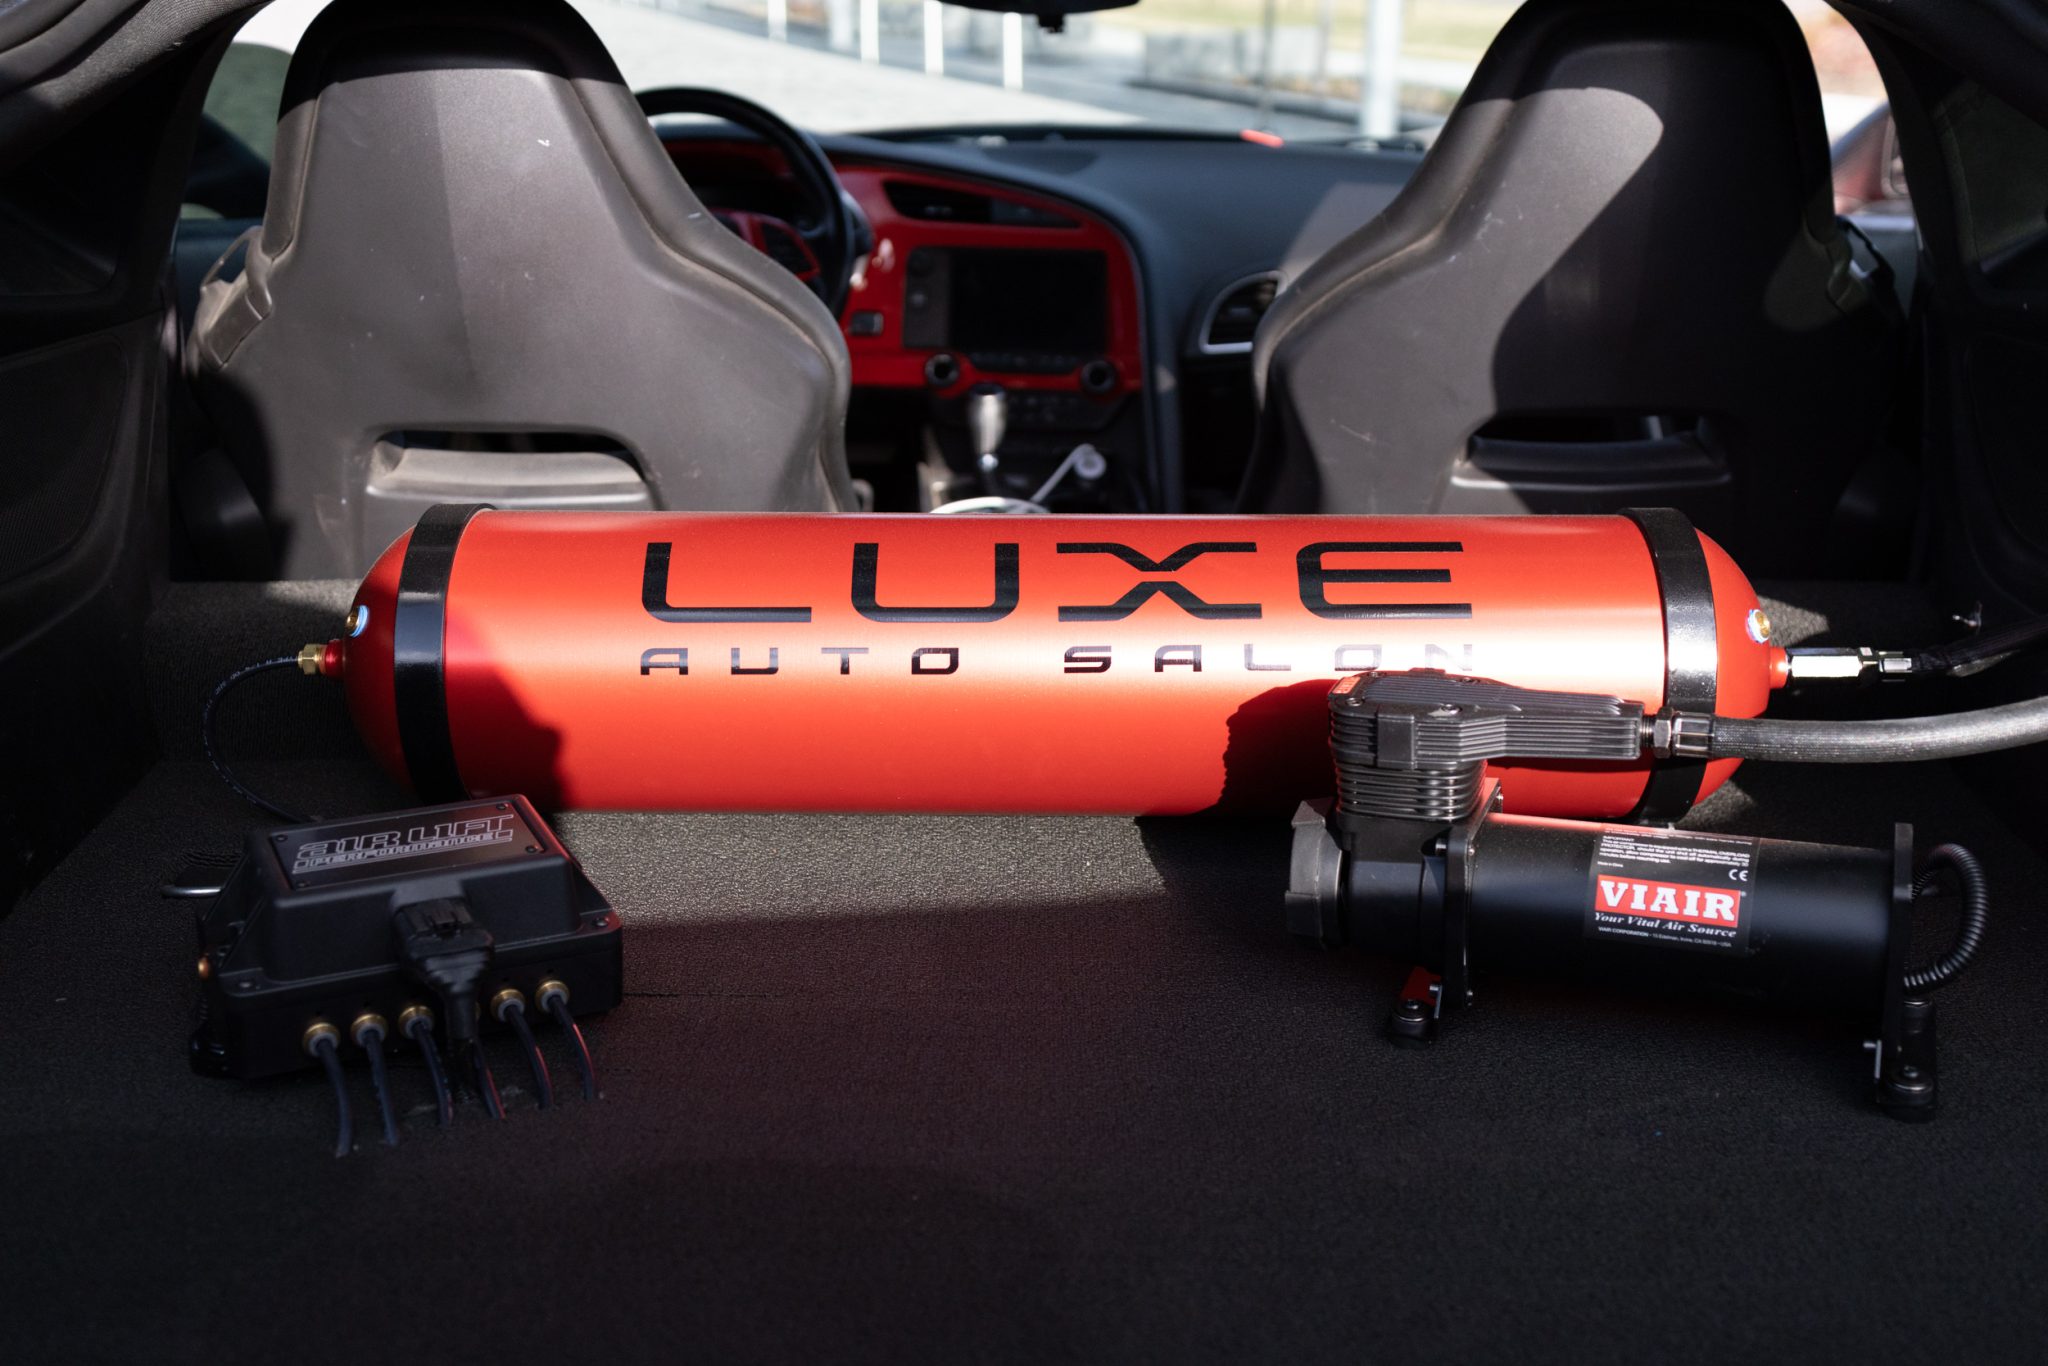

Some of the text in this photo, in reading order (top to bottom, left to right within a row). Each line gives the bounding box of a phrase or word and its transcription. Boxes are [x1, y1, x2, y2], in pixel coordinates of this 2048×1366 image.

[641, 541, 1472, 622] LUXE
[640, 643, 1473, 675] AUTO SALON
[408, 814, 514, 844] LIFT
[1600, 880, 1735, 921] VIAIR
[1595, 912, 1736, 937] Your Vital Air Source
